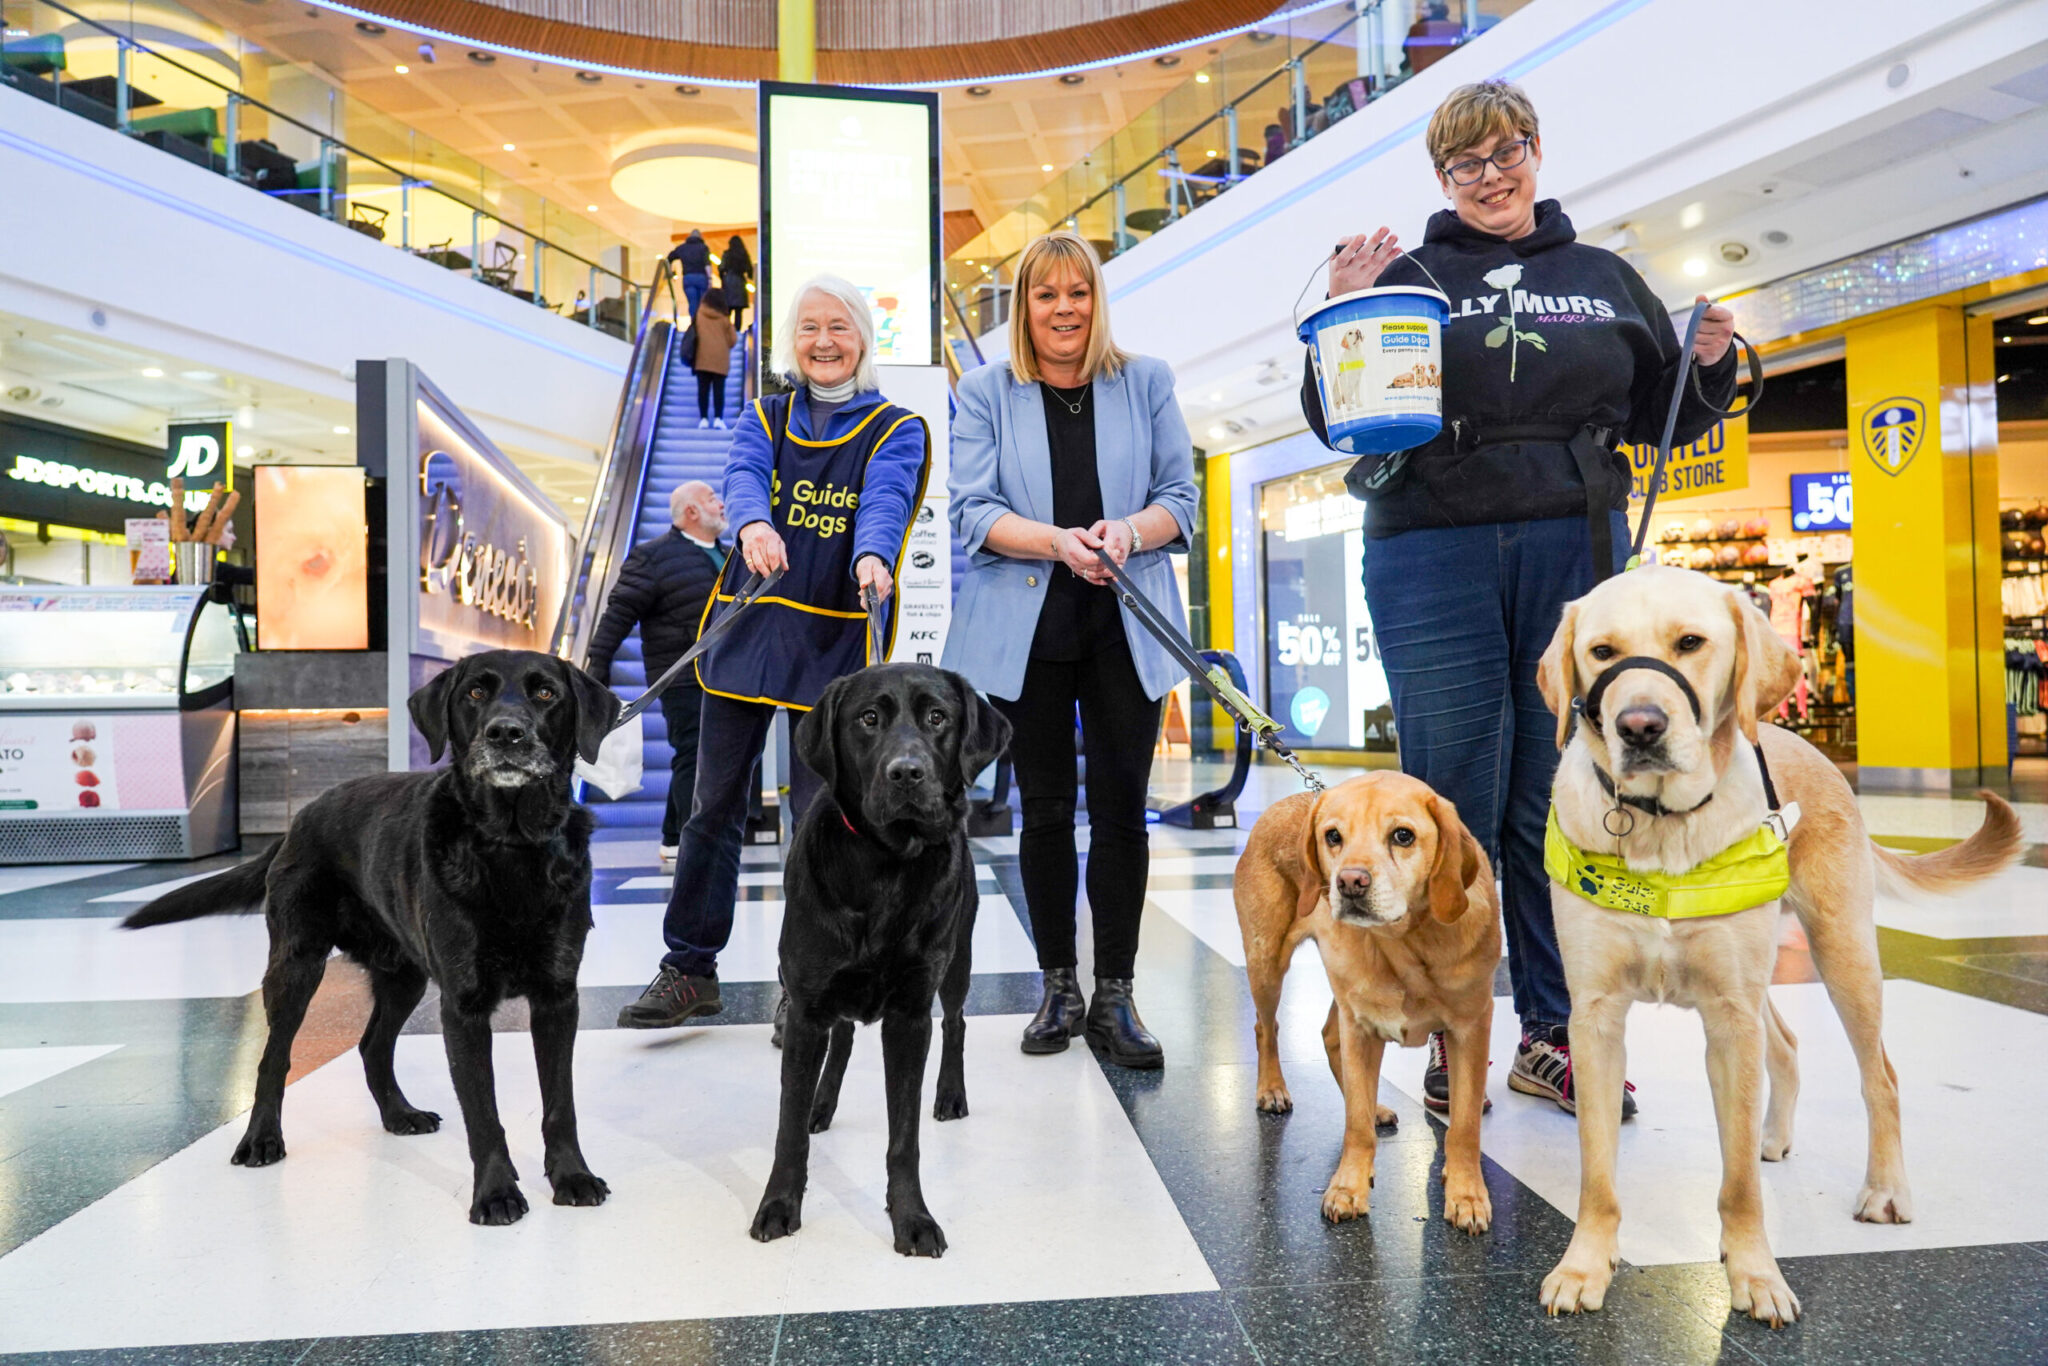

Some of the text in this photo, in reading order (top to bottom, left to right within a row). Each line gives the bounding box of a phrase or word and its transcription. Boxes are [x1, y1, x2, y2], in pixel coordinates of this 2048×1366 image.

[1514, 290, 1616, 318] MURS
[1535, 314, 1590, 323] MARRY
[1383, 335, 1428, 345] Guide Dogs
[167, 435, 219, 478] JD
[1630, 460, 1725, 498] CLB STORE
[792, 479, 859, 510] Guide
[786, 503, 848, 539] Dogs
[910, 631, 939, 640] KFC
